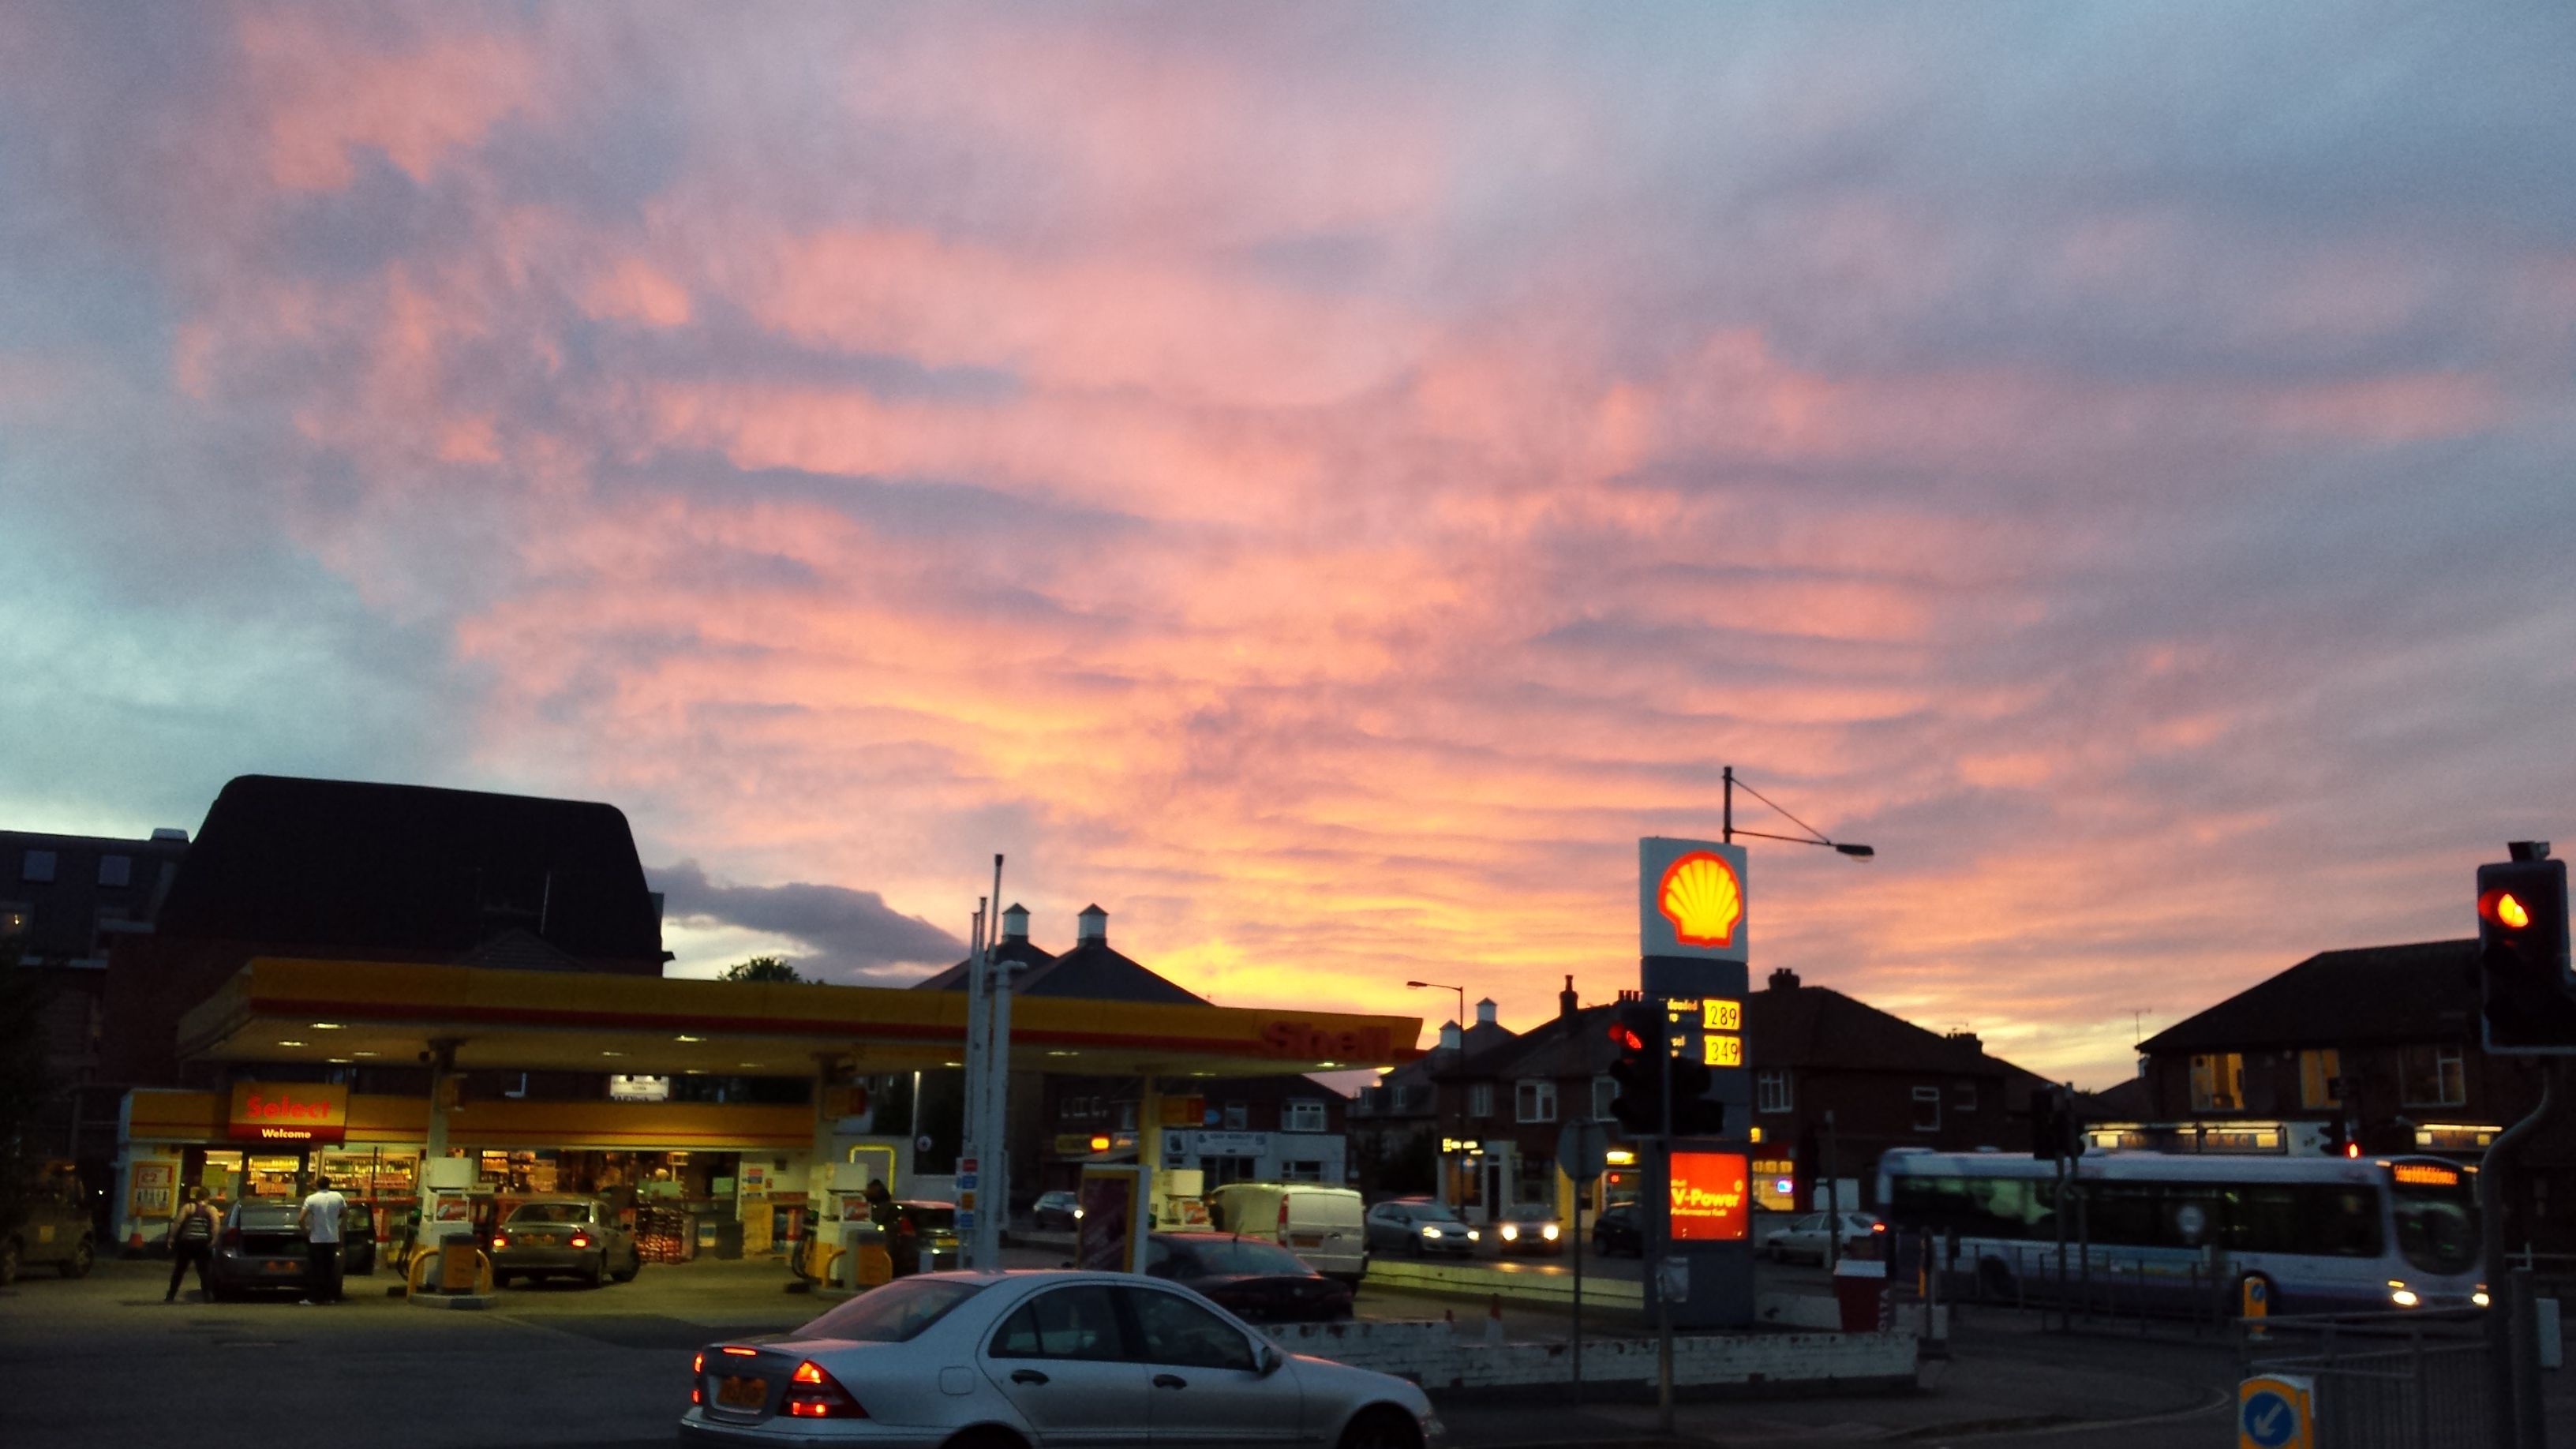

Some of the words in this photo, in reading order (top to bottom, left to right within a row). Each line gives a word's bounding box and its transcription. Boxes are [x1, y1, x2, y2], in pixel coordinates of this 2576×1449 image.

[1711, 1005, 1736, 1028] 289
[1261, 1020, 1391, 1061] Shell
[1711, 1041, 1738, 1063] 349
[246, 1093, 331, 1119] Select
[261, 1128, 312, 1139] Welcome
[1671, 1189, 1739, 1207] V-Power
[1878, 1288, 1889, 1331] OSTA
